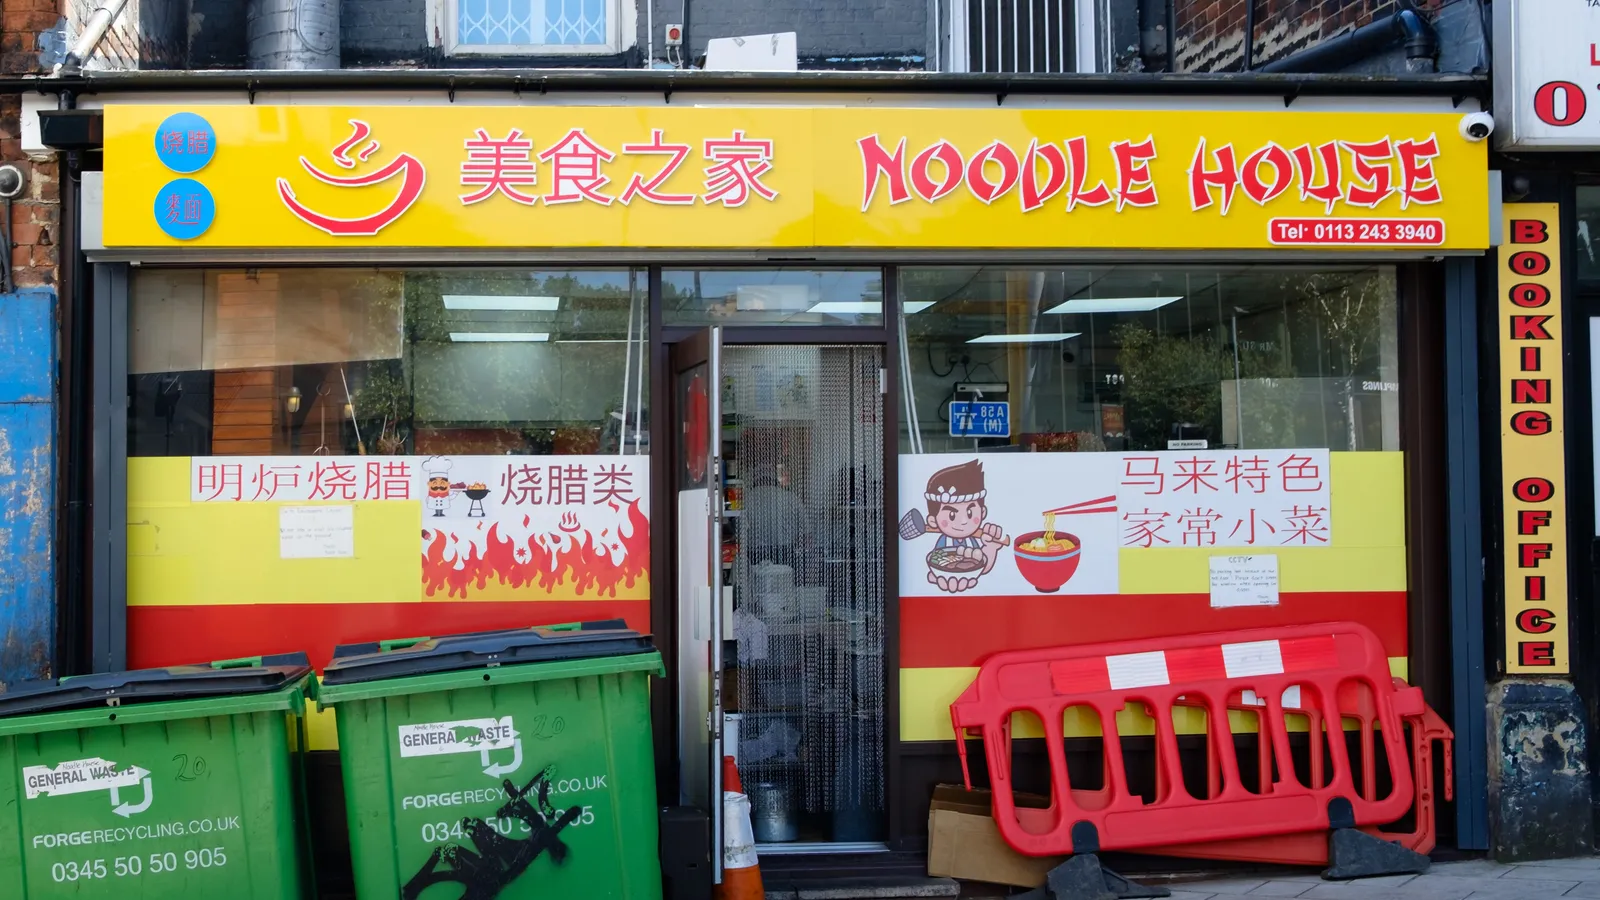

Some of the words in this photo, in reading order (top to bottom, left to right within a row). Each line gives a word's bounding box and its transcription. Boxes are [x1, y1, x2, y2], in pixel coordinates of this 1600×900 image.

[162, 129, 209, 154] 烧腊
[458, 127, 779, 208] 美食之家
[857, 133, 1159, 213] NOODLE
[1186, 132, 1443, 216] HOUSE
[1314, 223, 1354, 240] 0113
[1359, 224, 1390, 240] 243
[1395, 224, 1436, 241] 3940
[1508, 219, 1555, 436] BOOKING
[198, 460, 412, 501] 明炉烧腊
[500, 463, 634, 505] 烧腊类
[1120, 453, 1323, 495] 马来特色
[1122, 505, 1329, 548] 家常小菜
[1512, 477, 1557, 666] OFFICE
[403, 731, 458, 747] GENERA
[531, 714, 565, 740] 20
[28, 769, 87, 788] GENERAL
[89, 765, 135, 780] WASE
[172, 753, 208, 781] 20
[32, 815, 241, 849] FORGERECYCLING.CO.UK
[421, 821, 475, 843] 034
[554, 806, 595, 827] 95
[51, 859, 107, 882] 0345
[114, 856, 142, 877] 50
[149, 852, 177, 873] 50
[184, 847, 227, 869] 905
